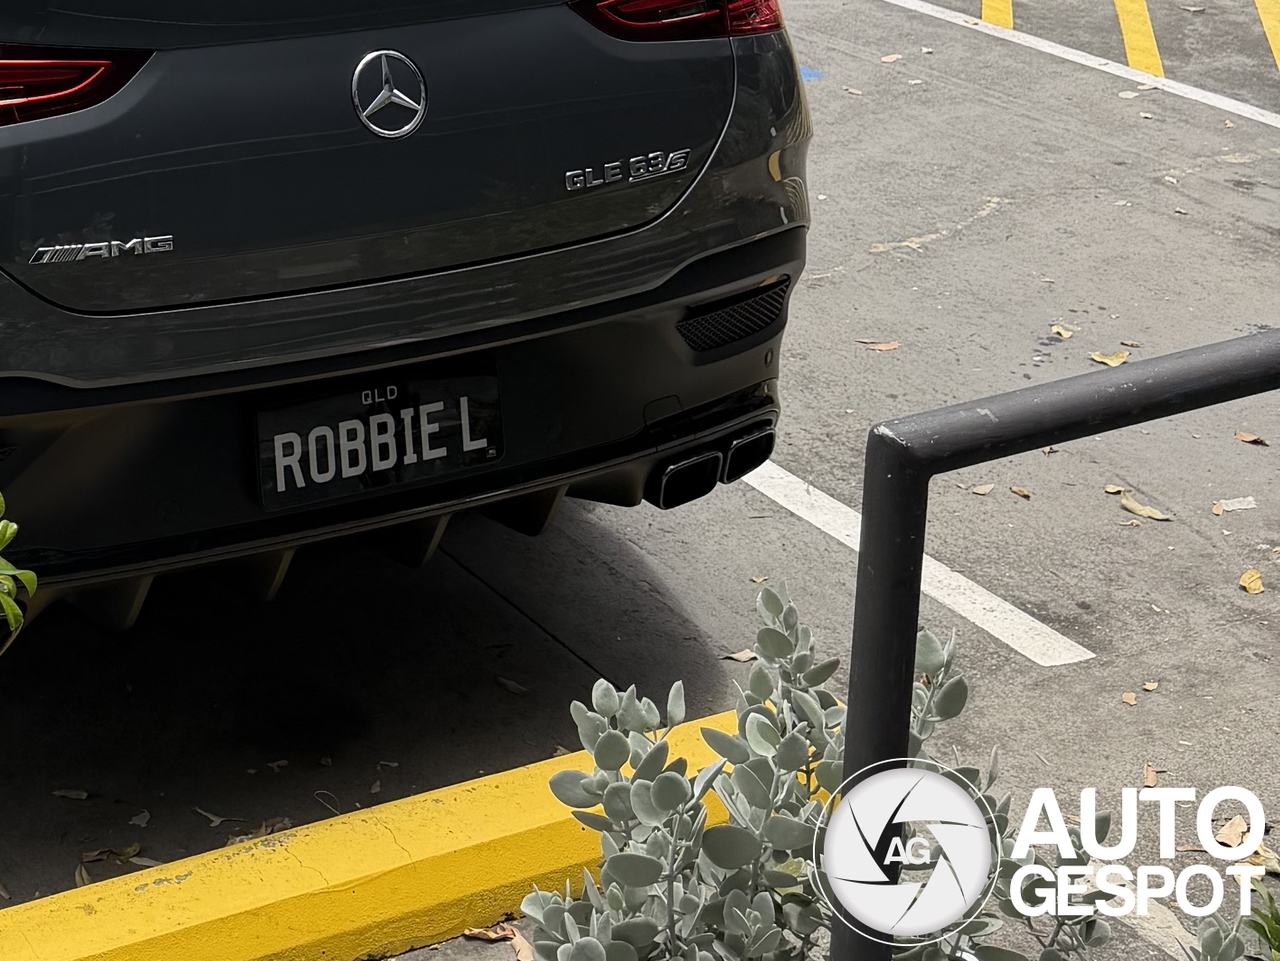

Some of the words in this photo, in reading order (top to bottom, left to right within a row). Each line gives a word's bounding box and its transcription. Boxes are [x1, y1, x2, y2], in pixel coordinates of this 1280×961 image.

[565, 161, 623, 190] GLE
[76, 235, 174, 260] AMG
[361, 385, 398, 405] QLD
[274, 401, 447, 492] ROBBIE
[459, 396, 488, 452] L
